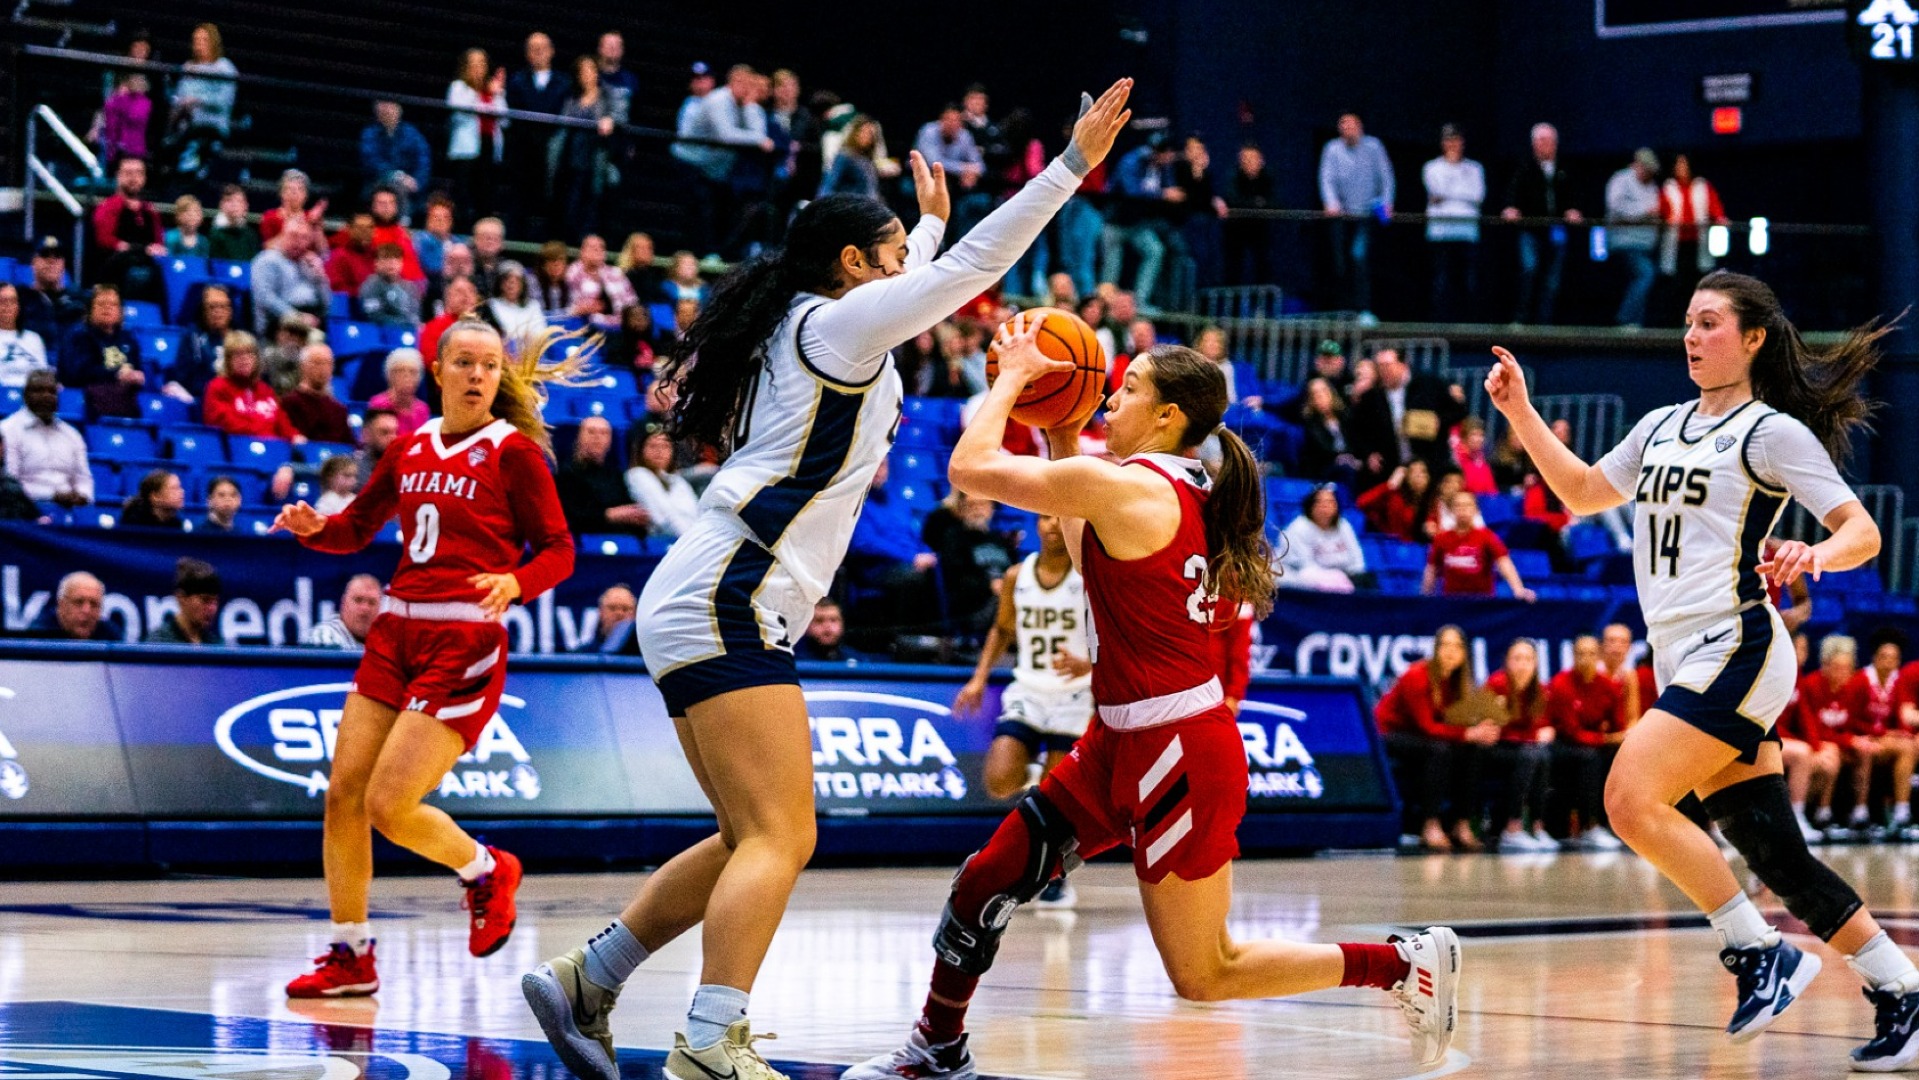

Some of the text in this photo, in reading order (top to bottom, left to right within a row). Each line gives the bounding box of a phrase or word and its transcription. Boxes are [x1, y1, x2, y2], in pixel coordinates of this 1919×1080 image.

[1870, 22, 1914, 59] 21
[399, 471, 478, 500] MIAMI
[1635, 464, 1712, 507] ZIPS
[408, 502, 440, 564] 0
[1649, 512, 1682, 578] 14
[1021, 605, 1077, 630] ZIPS
[436, 770, 516, 798] ARK
[860, 771, 945, 799] PARK
